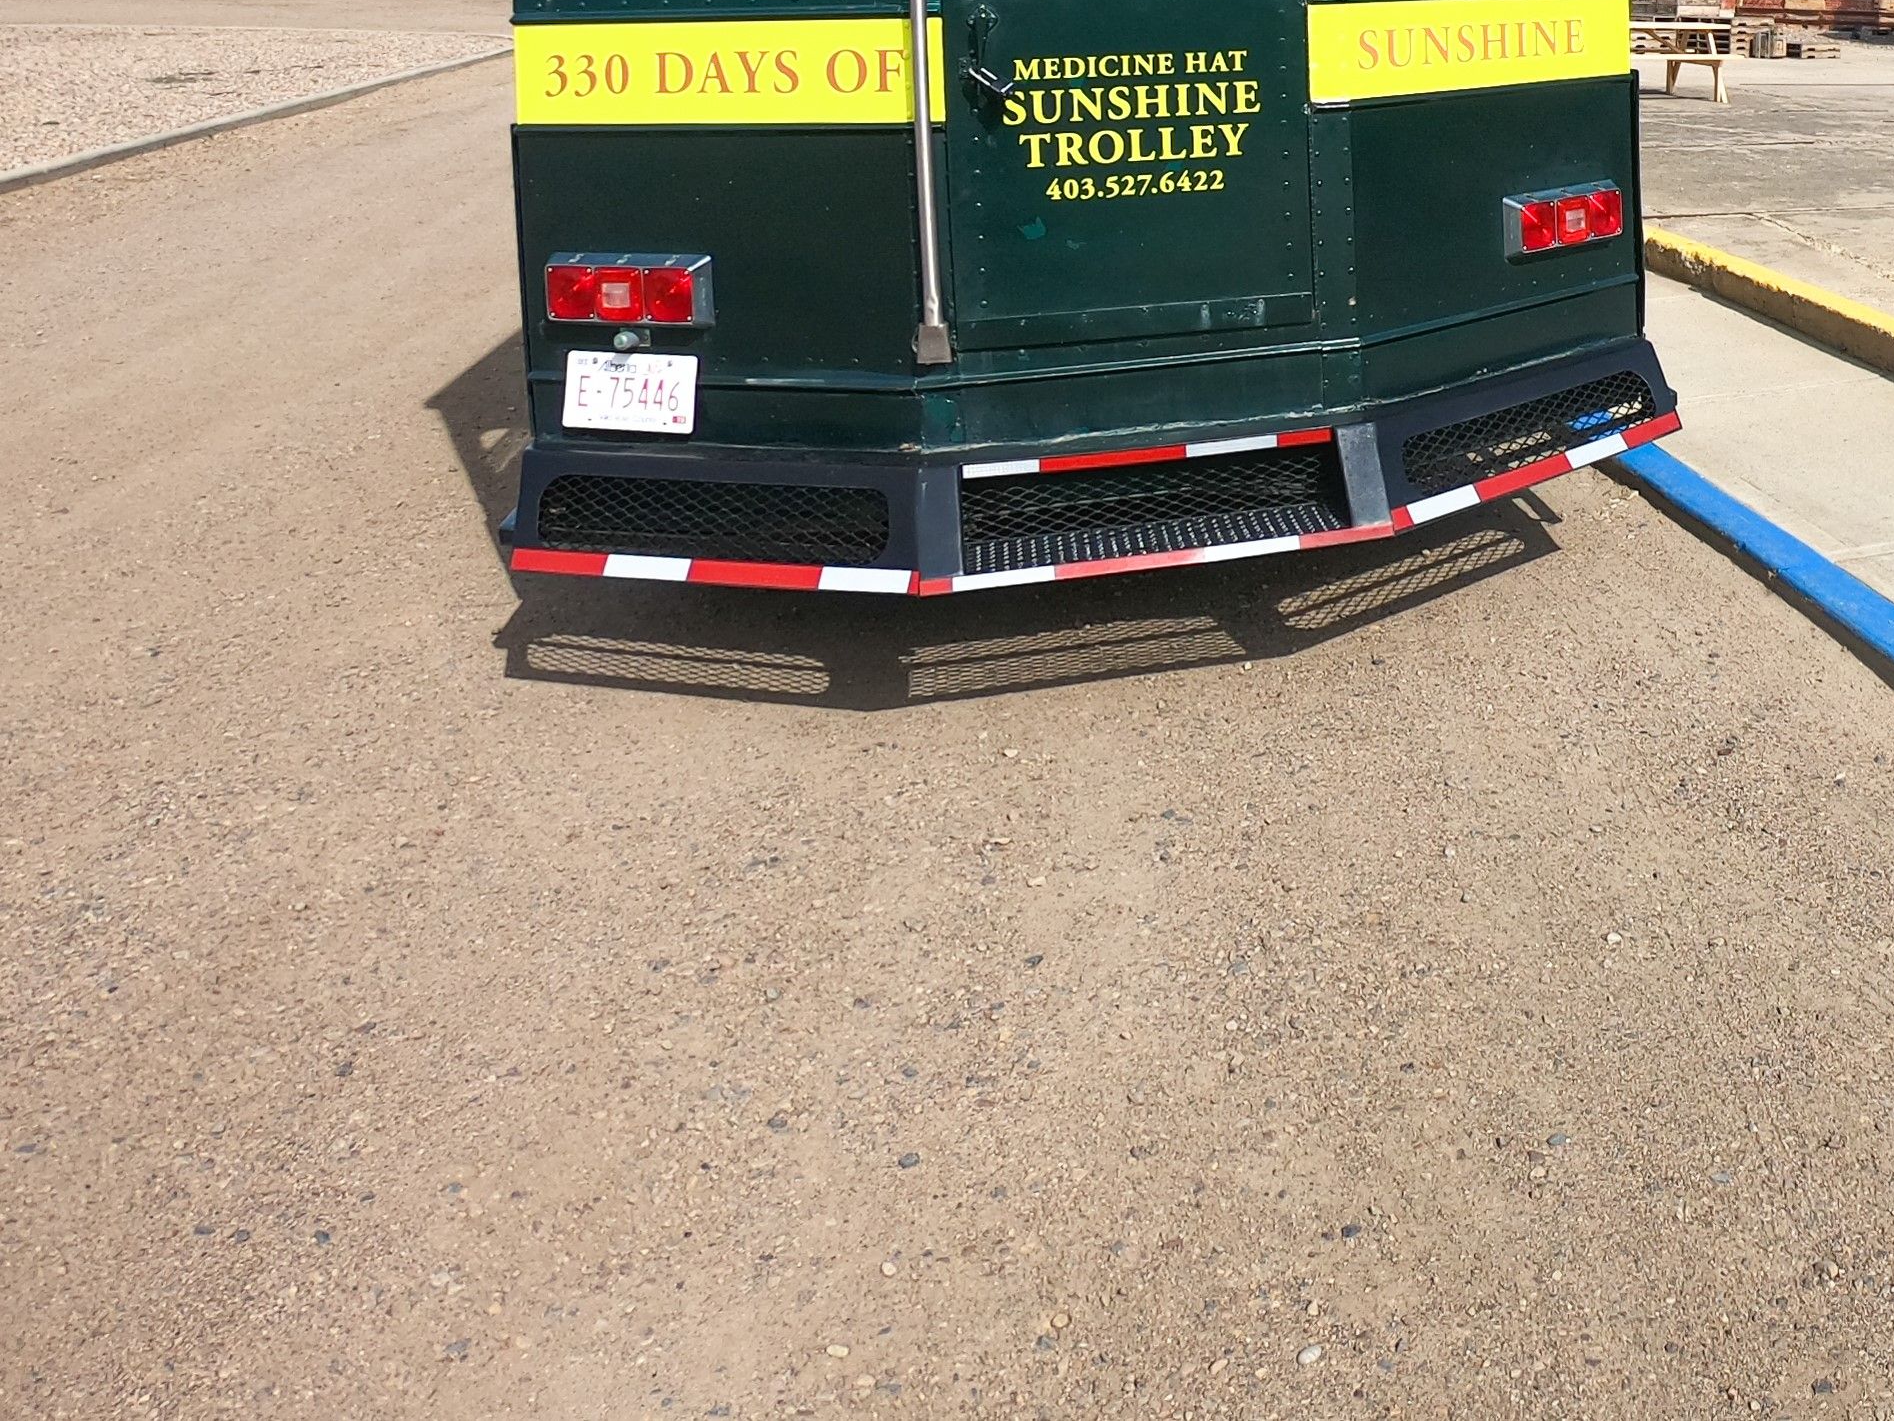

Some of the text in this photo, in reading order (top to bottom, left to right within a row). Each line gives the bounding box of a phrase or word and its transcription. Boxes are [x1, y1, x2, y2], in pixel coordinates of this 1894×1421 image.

[1013, 50, 1248, 81] MEDICINE HAT
[1357, 19, 1585, 70] SUNSHINE
[544, 48, 909, 97] 330 DAYS OF
[1002, 80, 1262, 126] SUNSHINE
[1018, 123, 1250, 168] TROLLEY
[1045, 169, 1226, 200] 403.527.6422
[577, 374, 681, 412] E-75446
